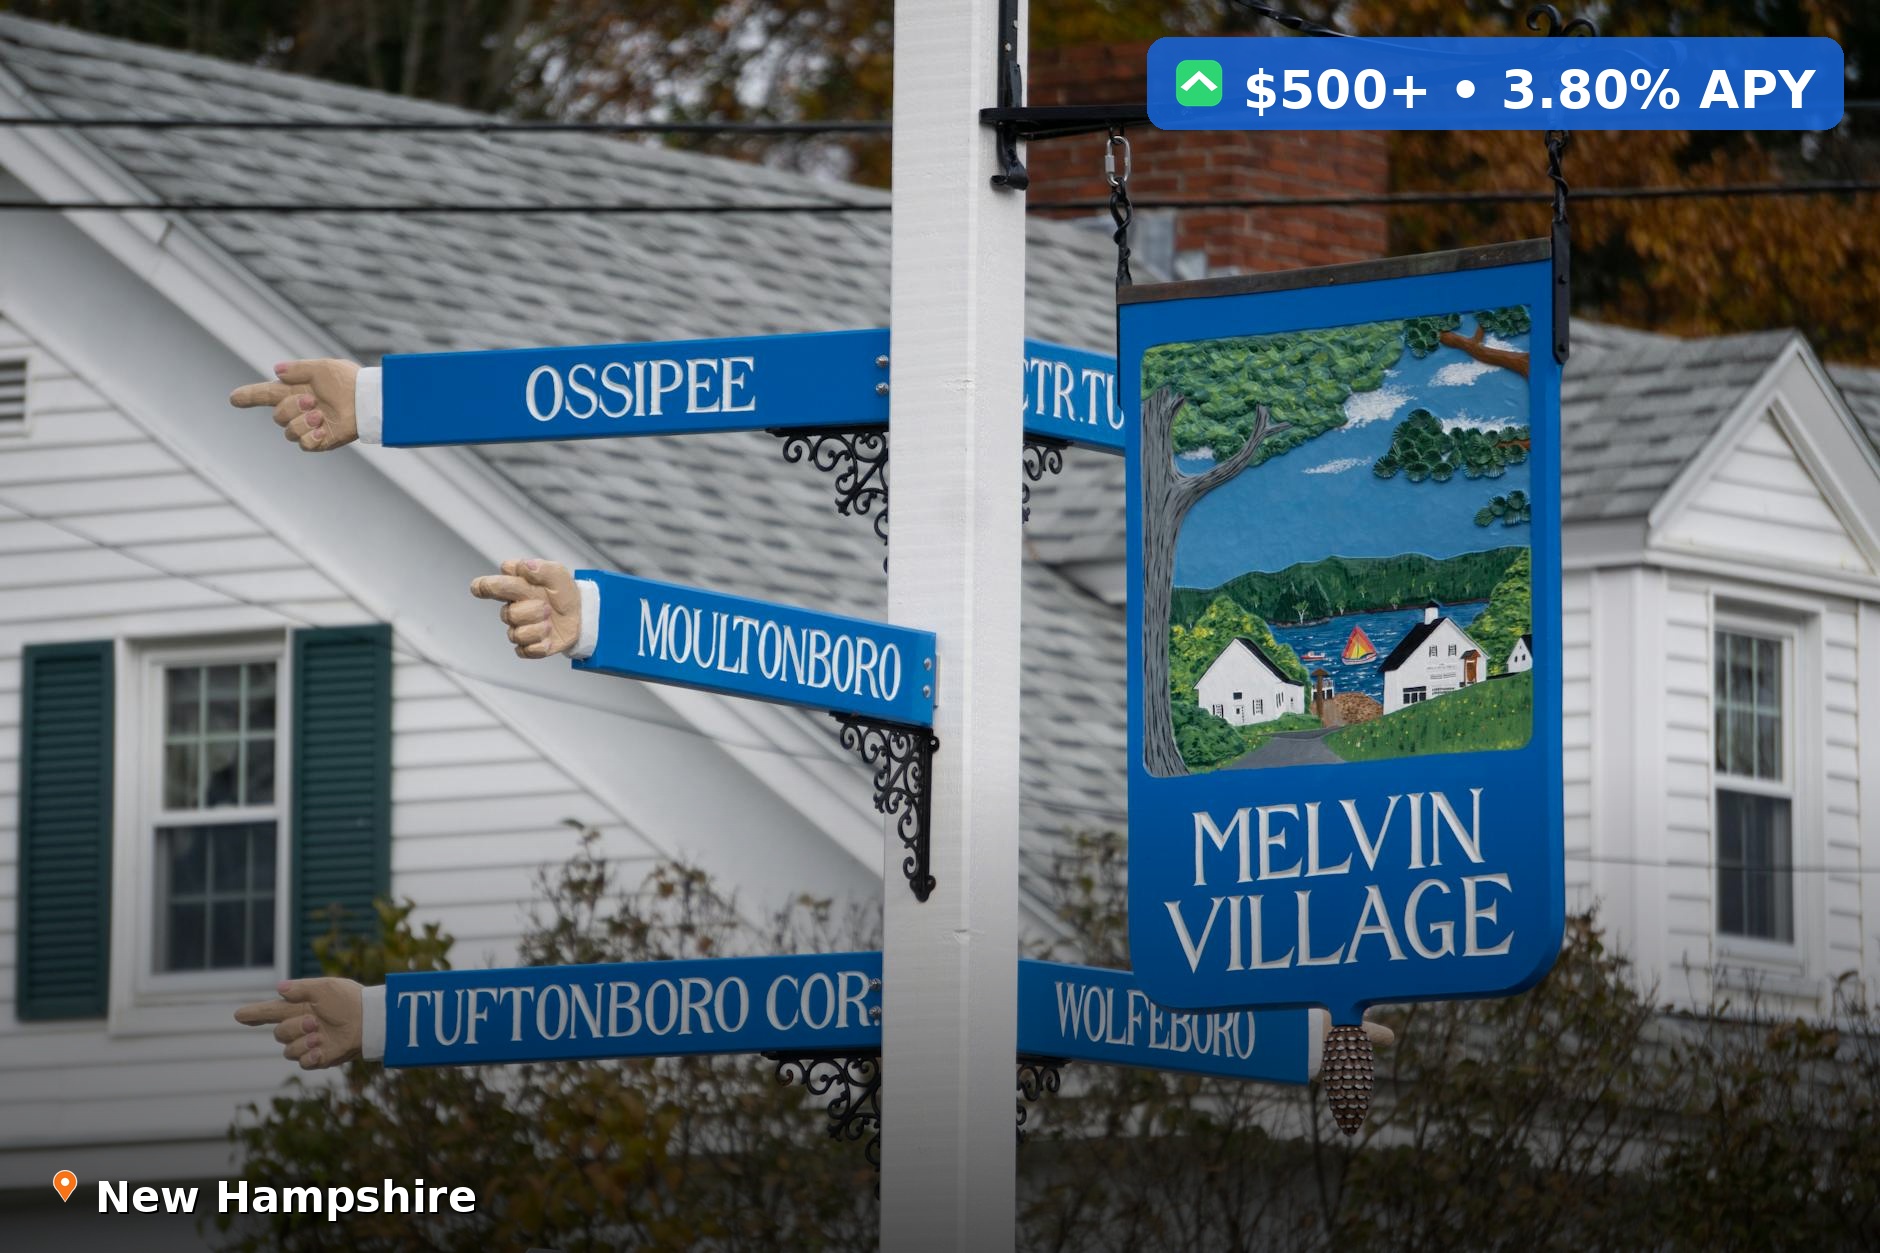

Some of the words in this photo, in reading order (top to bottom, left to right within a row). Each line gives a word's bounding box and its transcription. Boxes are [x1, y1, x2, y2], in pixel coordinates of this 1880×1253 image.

[525, 356, 756, 422] OSSIPEE
[637, 597, 902, 702] MOULTONBORO
[1192, 787, 1486, 887] MELVIN
[1164, 872, 1515, 975] VILLAGE
[396, 976, 749, 1048] TUFTONBORO
[766, 970, 881, 1031] COR.
